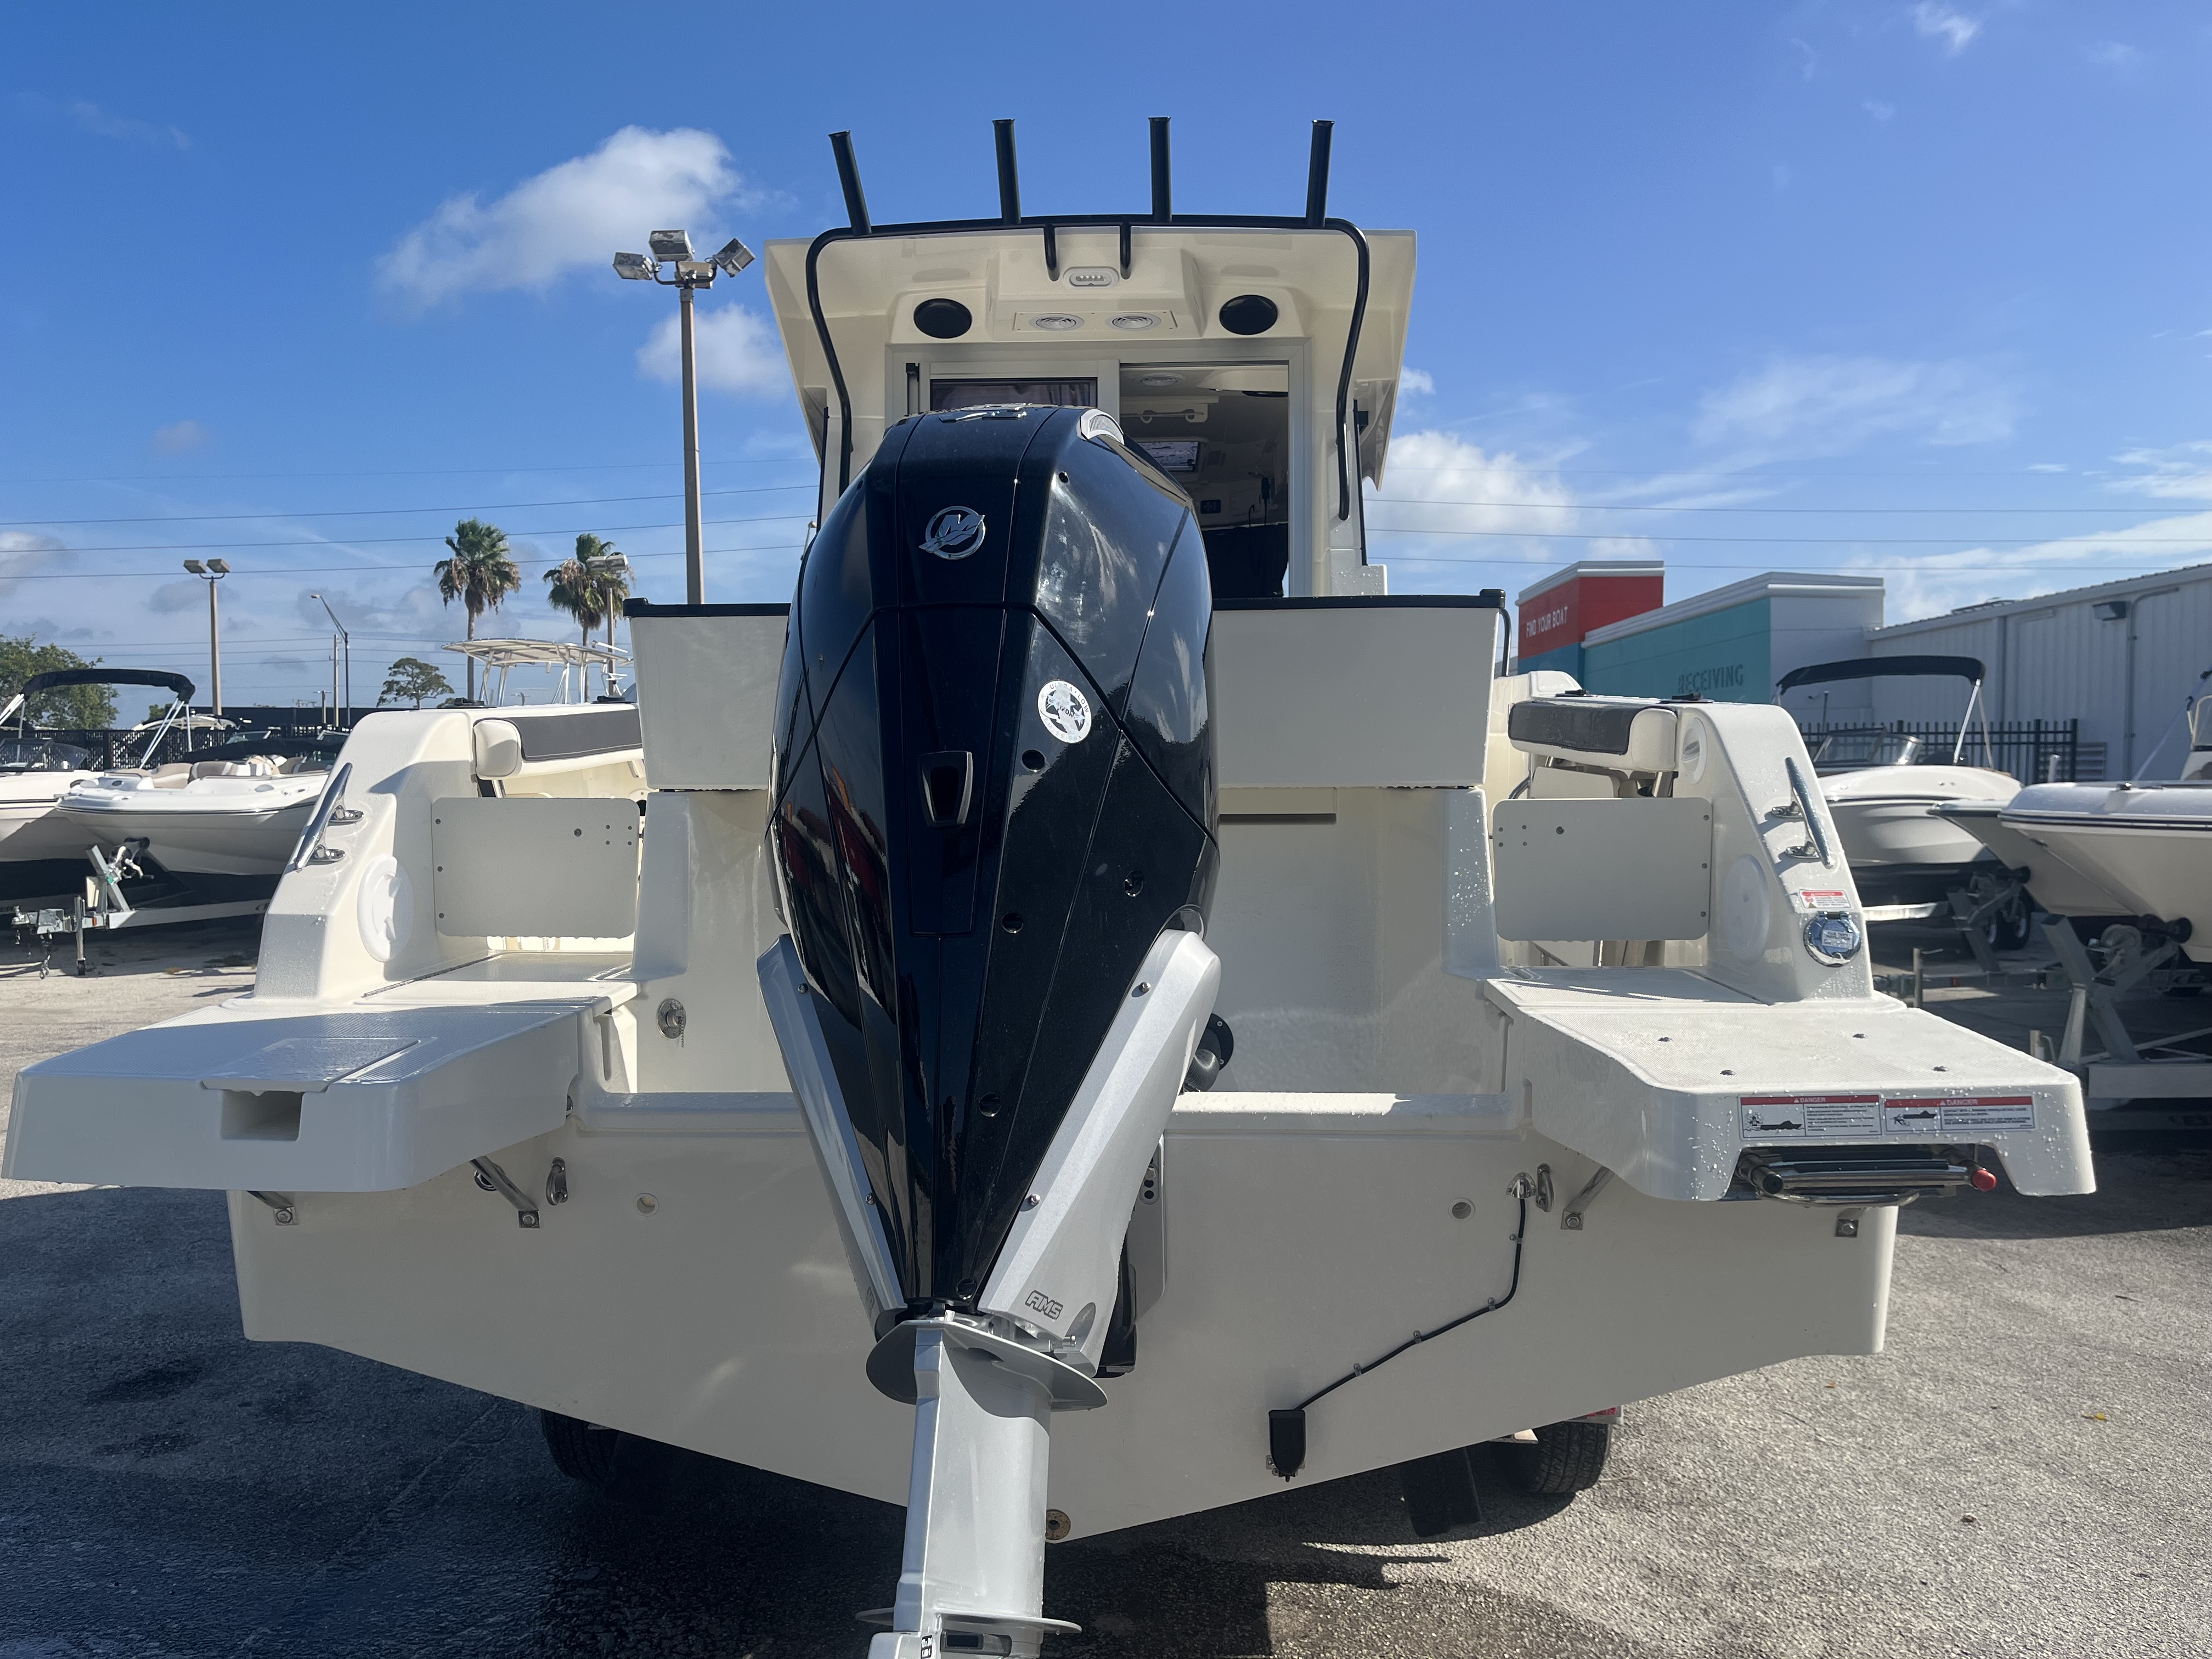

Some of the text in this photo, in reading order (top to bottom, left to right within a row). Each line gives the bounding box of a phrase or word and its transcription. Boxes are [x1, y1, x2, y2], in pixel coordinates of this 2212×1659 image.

[1526, 606, 1568, 637] FIND YOUR BOAT
[1678, 663, 1743, 694] RECEIVING
[1077, 693, 1089, 713] LOW
[1024, 1290, 1064, 1321] AMS
